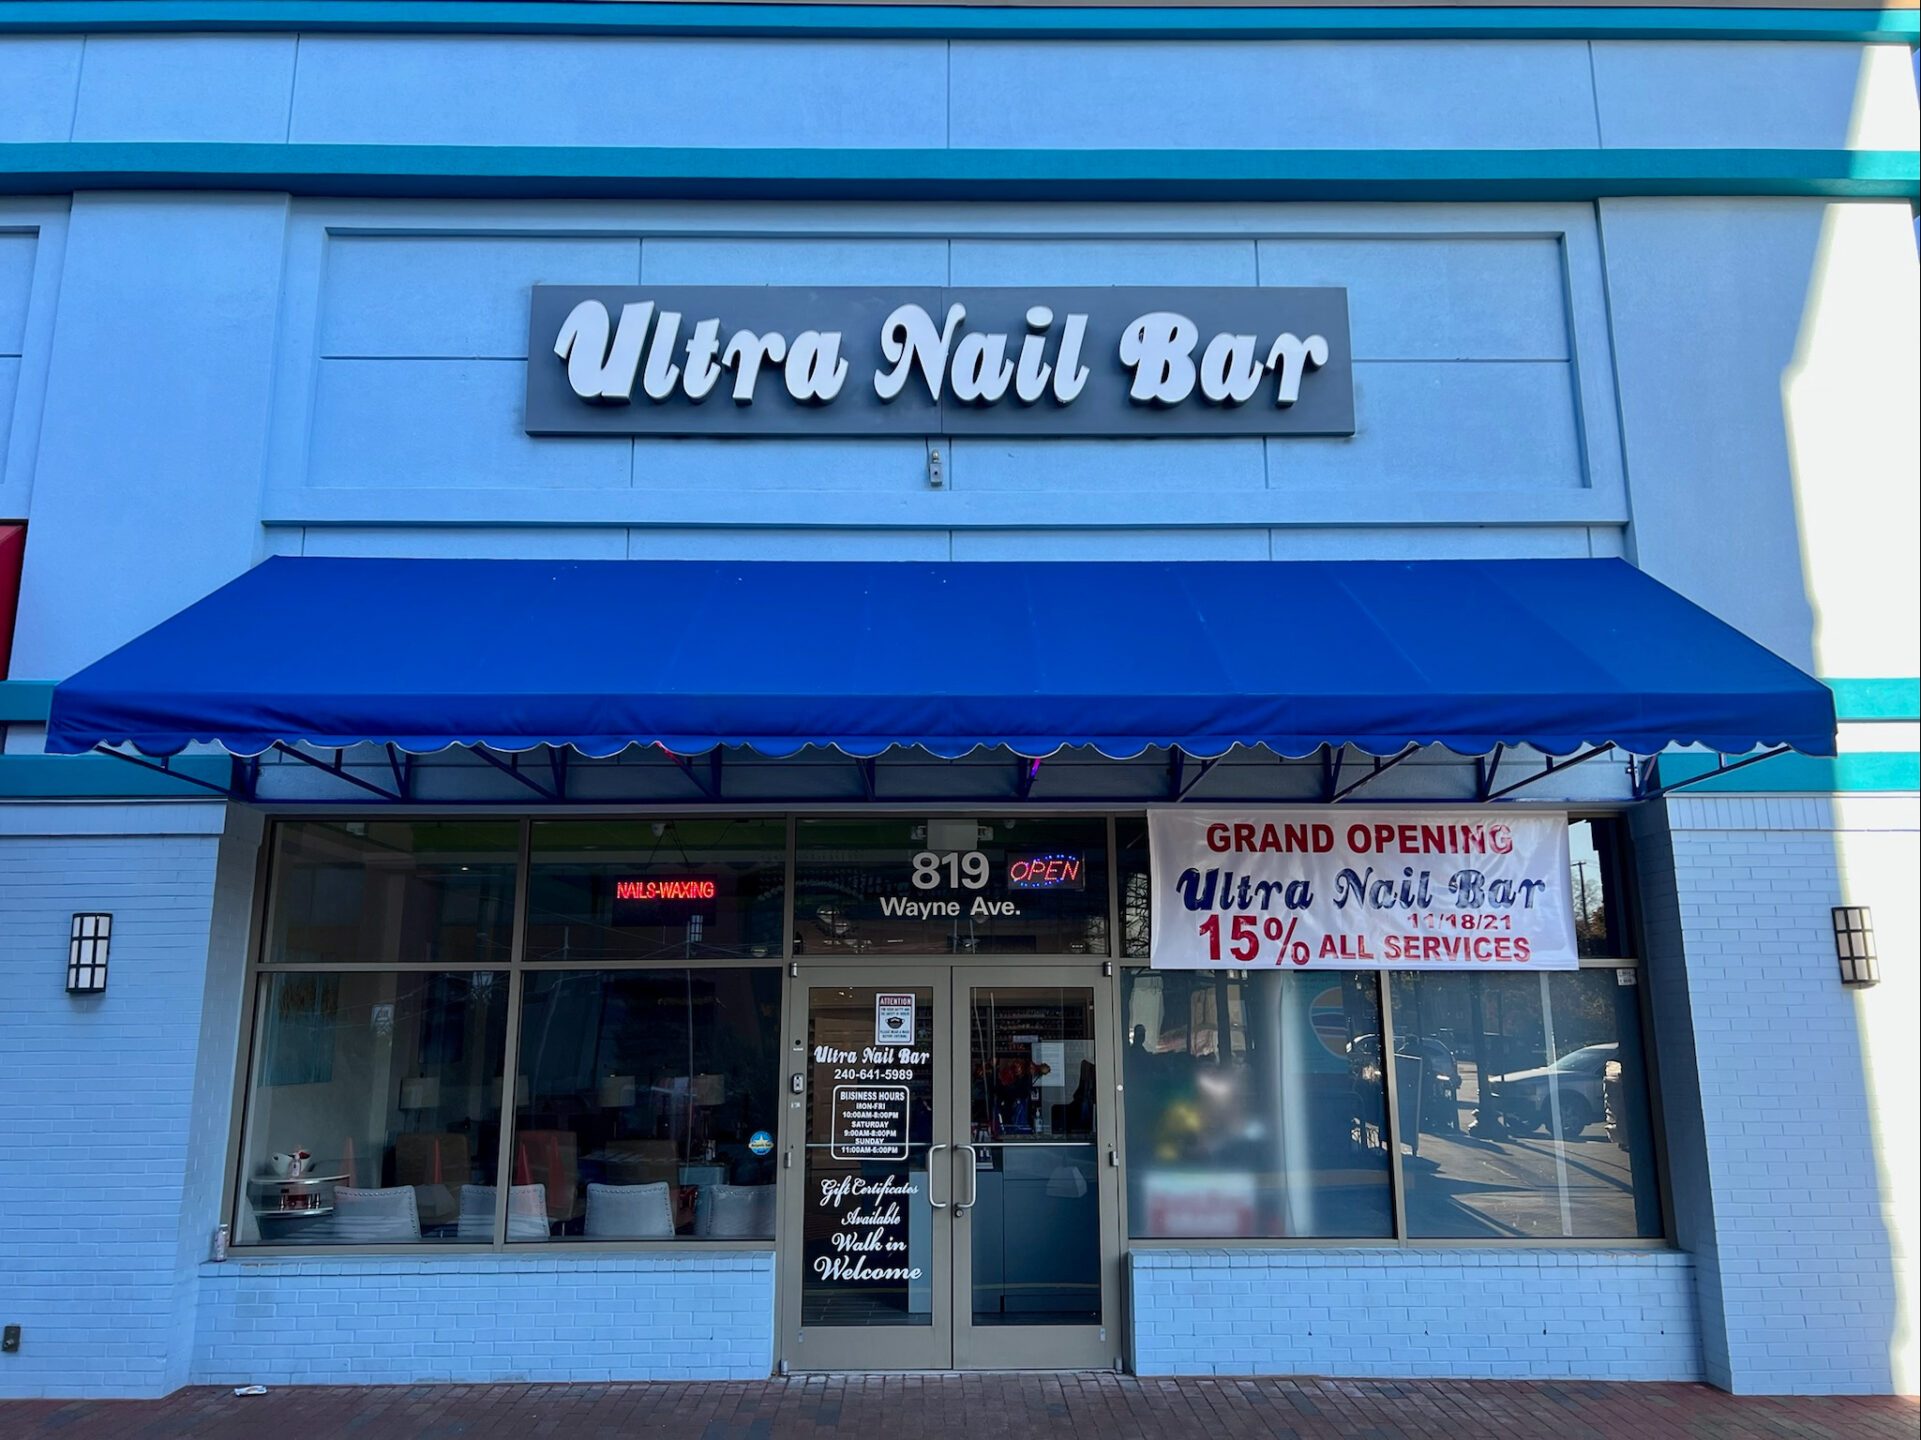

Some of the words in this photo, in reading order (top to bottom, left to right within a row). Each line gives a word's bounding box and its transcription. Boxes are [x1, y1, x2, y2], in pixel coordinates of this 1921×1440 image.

[553, 299, 848, 402] Ultra
[873, 301, 1090, 404] Nail
[1118, 310, 1330, 406] Bar
[1206, 823, 1334, 853] GRAND
[1346, 824, 1514, 855] OPENING
[911, 851, 990, 890] 819
[1010, 859, 1080, 881] OPEN
[616, 881, 714, 899] NAILS-WAXING
[1175, 867, 1314, 911] Ultra
[1333, 867, 1434, 911] Nail
[1448, 869, 1546, 910] Bar
[879, 897, 960, 920] Wayne
[970, 897, 1021, 916] Ave.
[1406, 913, 1511, 930] 11/18/21
[1199, 914, 1310, 966] 15%
[1319, 934, 1374, 960] ALL
[1384, 934, 1531, 962] SERVICES
[880, 997, 911, 1006] ATTENTION
[814, 1045, 857, 1064] Ultra
[862, 1047, 894, 1064] Nail
[898, 1048, 930, 1065] Bar
[834, 1069, 913, 1080] 240-641-5989
[840, 1092, 877, 1101] BUSINESS
[879, 1092, 905, 1101] HOURS
[820, 1175, 851, 1207] Gift
[852, 1174, 919, 1206] Certificates
[841, 1202, 901, 1225] Available
[831, 1227, 883, 1252] Walk
[885, 1236, 907, 1252] in
[813, 1255, 922, 1281] Welcome
